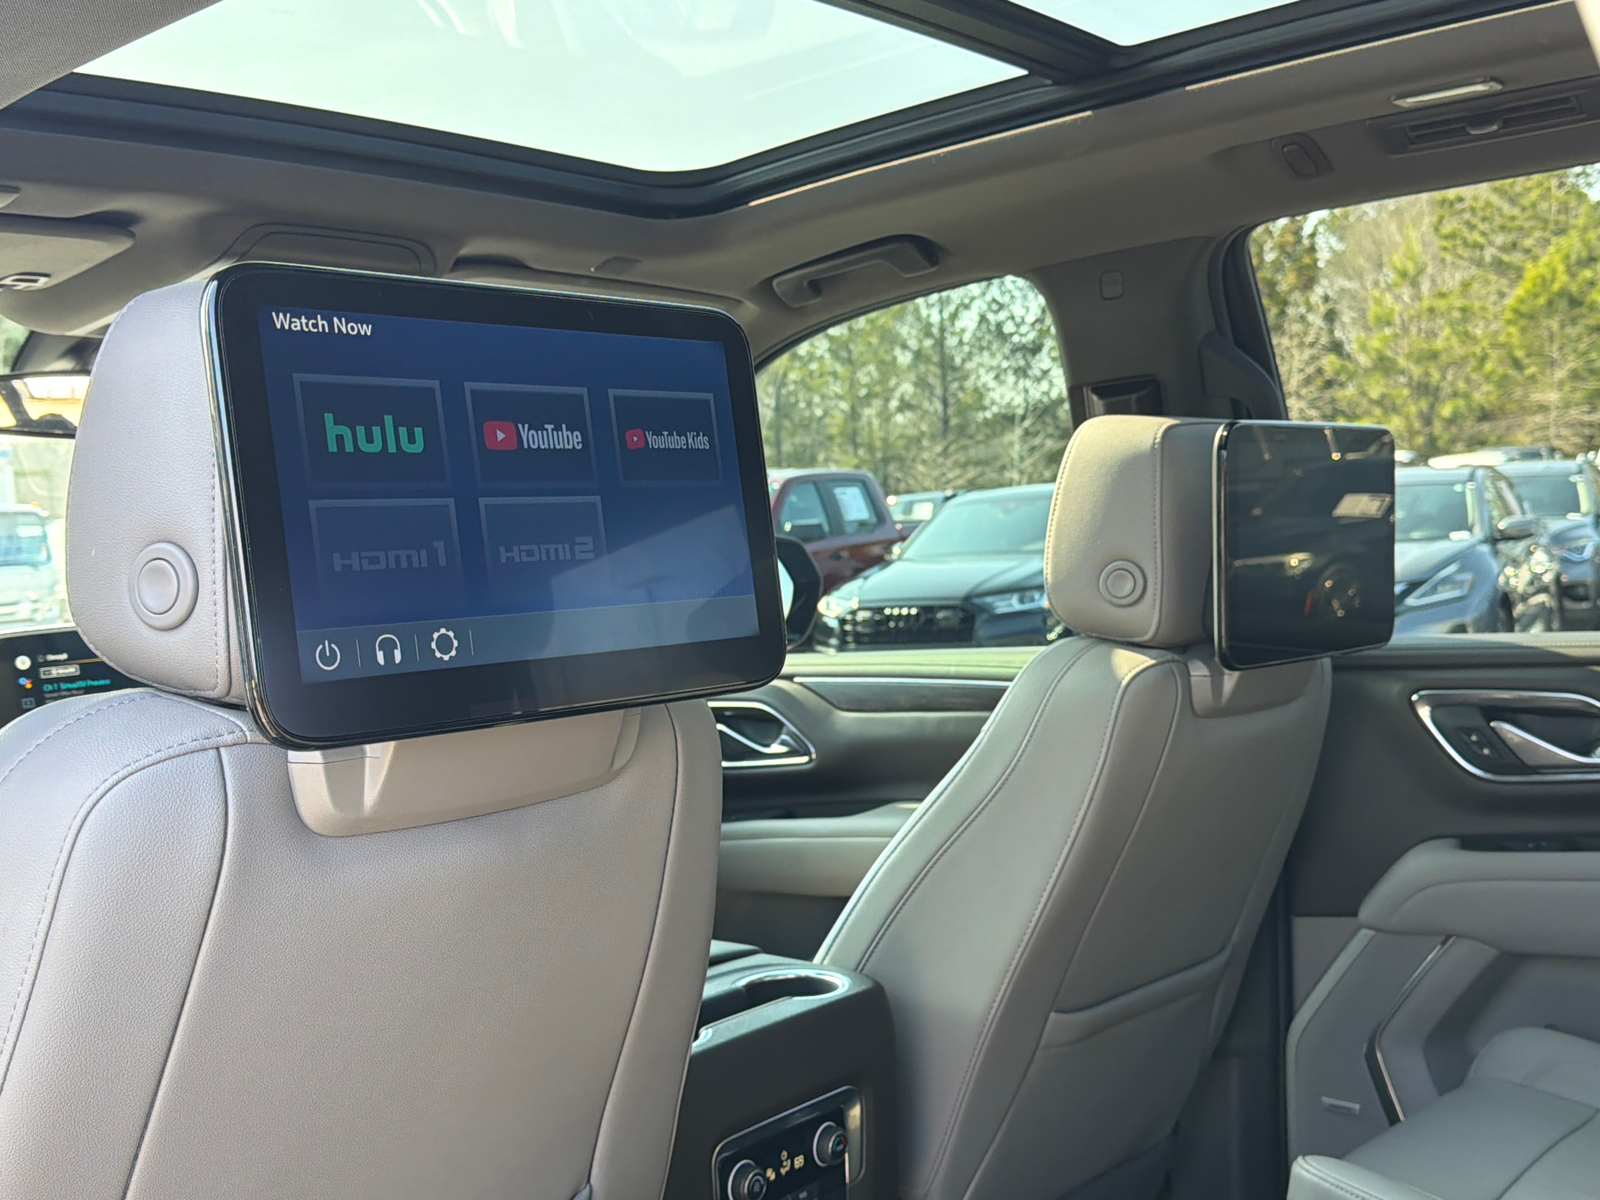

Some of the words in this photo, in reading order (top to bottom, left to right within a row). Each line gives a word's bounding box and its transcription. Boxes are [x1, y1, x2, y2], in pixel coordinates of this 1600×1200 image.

[271, 311, 329, 333] Watch
[332, 316, 372, 336] Now
[323, 412, 425, 454] hulu
[517, 423, 583, 450] YouTube
[645, 430, 687, 449] YouTube
[686, 431, 710, 450] Kids
[332, 549, 428, 572] HDMI
[432, 540, 447, 567] 1
[499, 543, 572, 564] HDMI
[574, 536, 595, 561] 2
